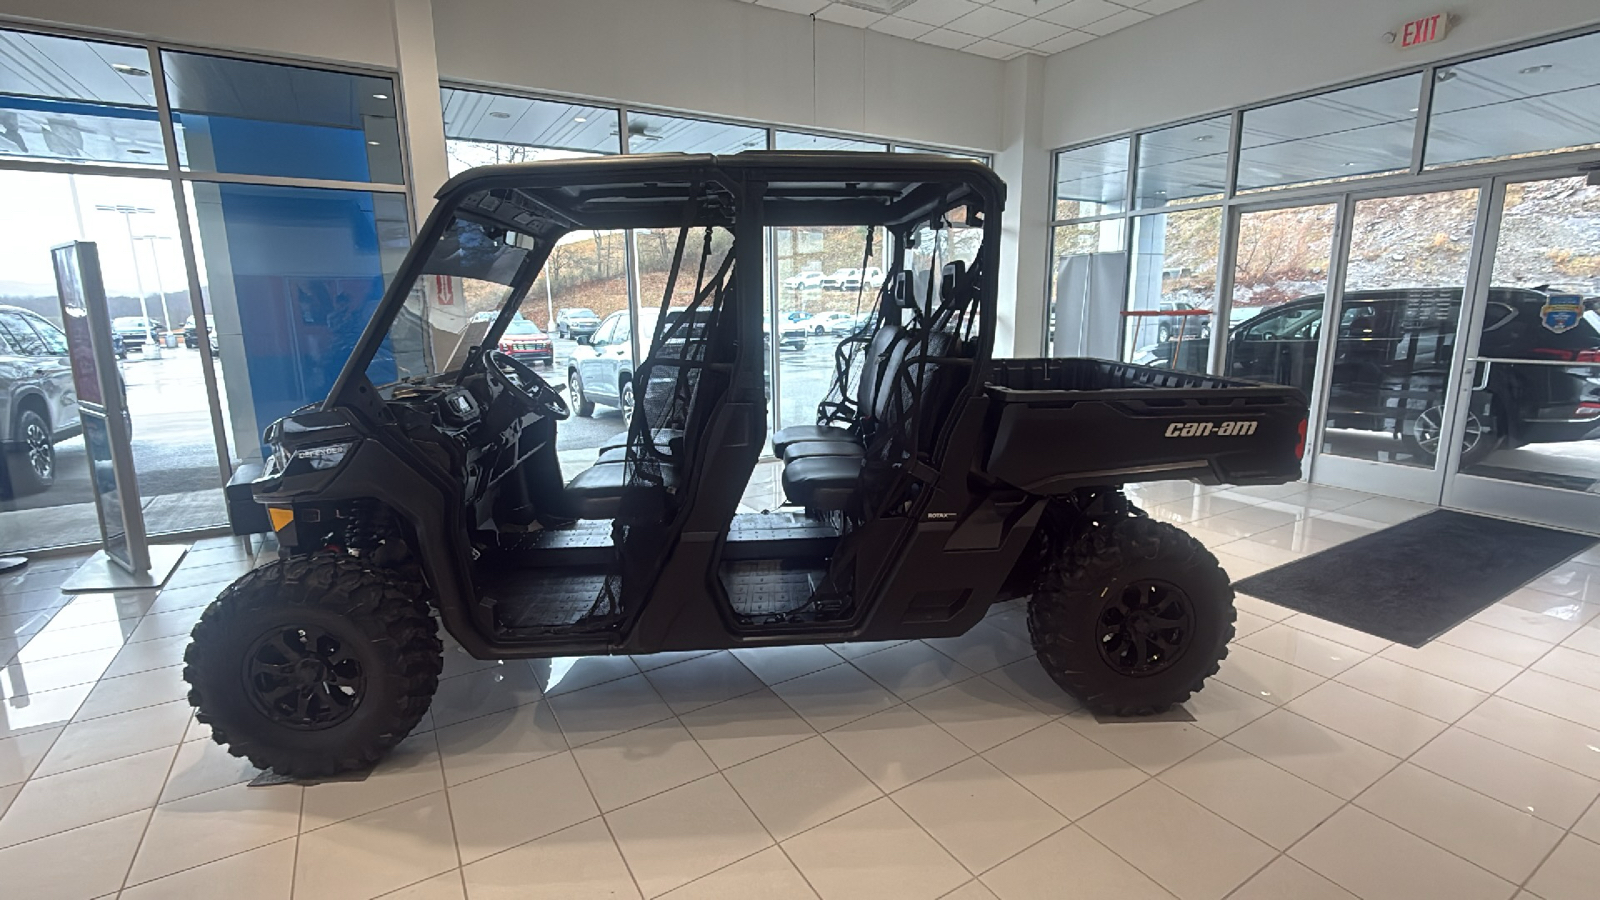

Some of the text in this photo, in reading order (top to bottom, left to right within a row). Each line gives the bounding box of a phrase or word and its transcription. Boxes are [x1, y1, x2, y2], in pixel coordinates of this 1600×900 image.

[1402, 14, 1440, 47] EXIT
[1164, 421, 1258, 438] can-am
[298, 446, 344, 460] DEFENDER
